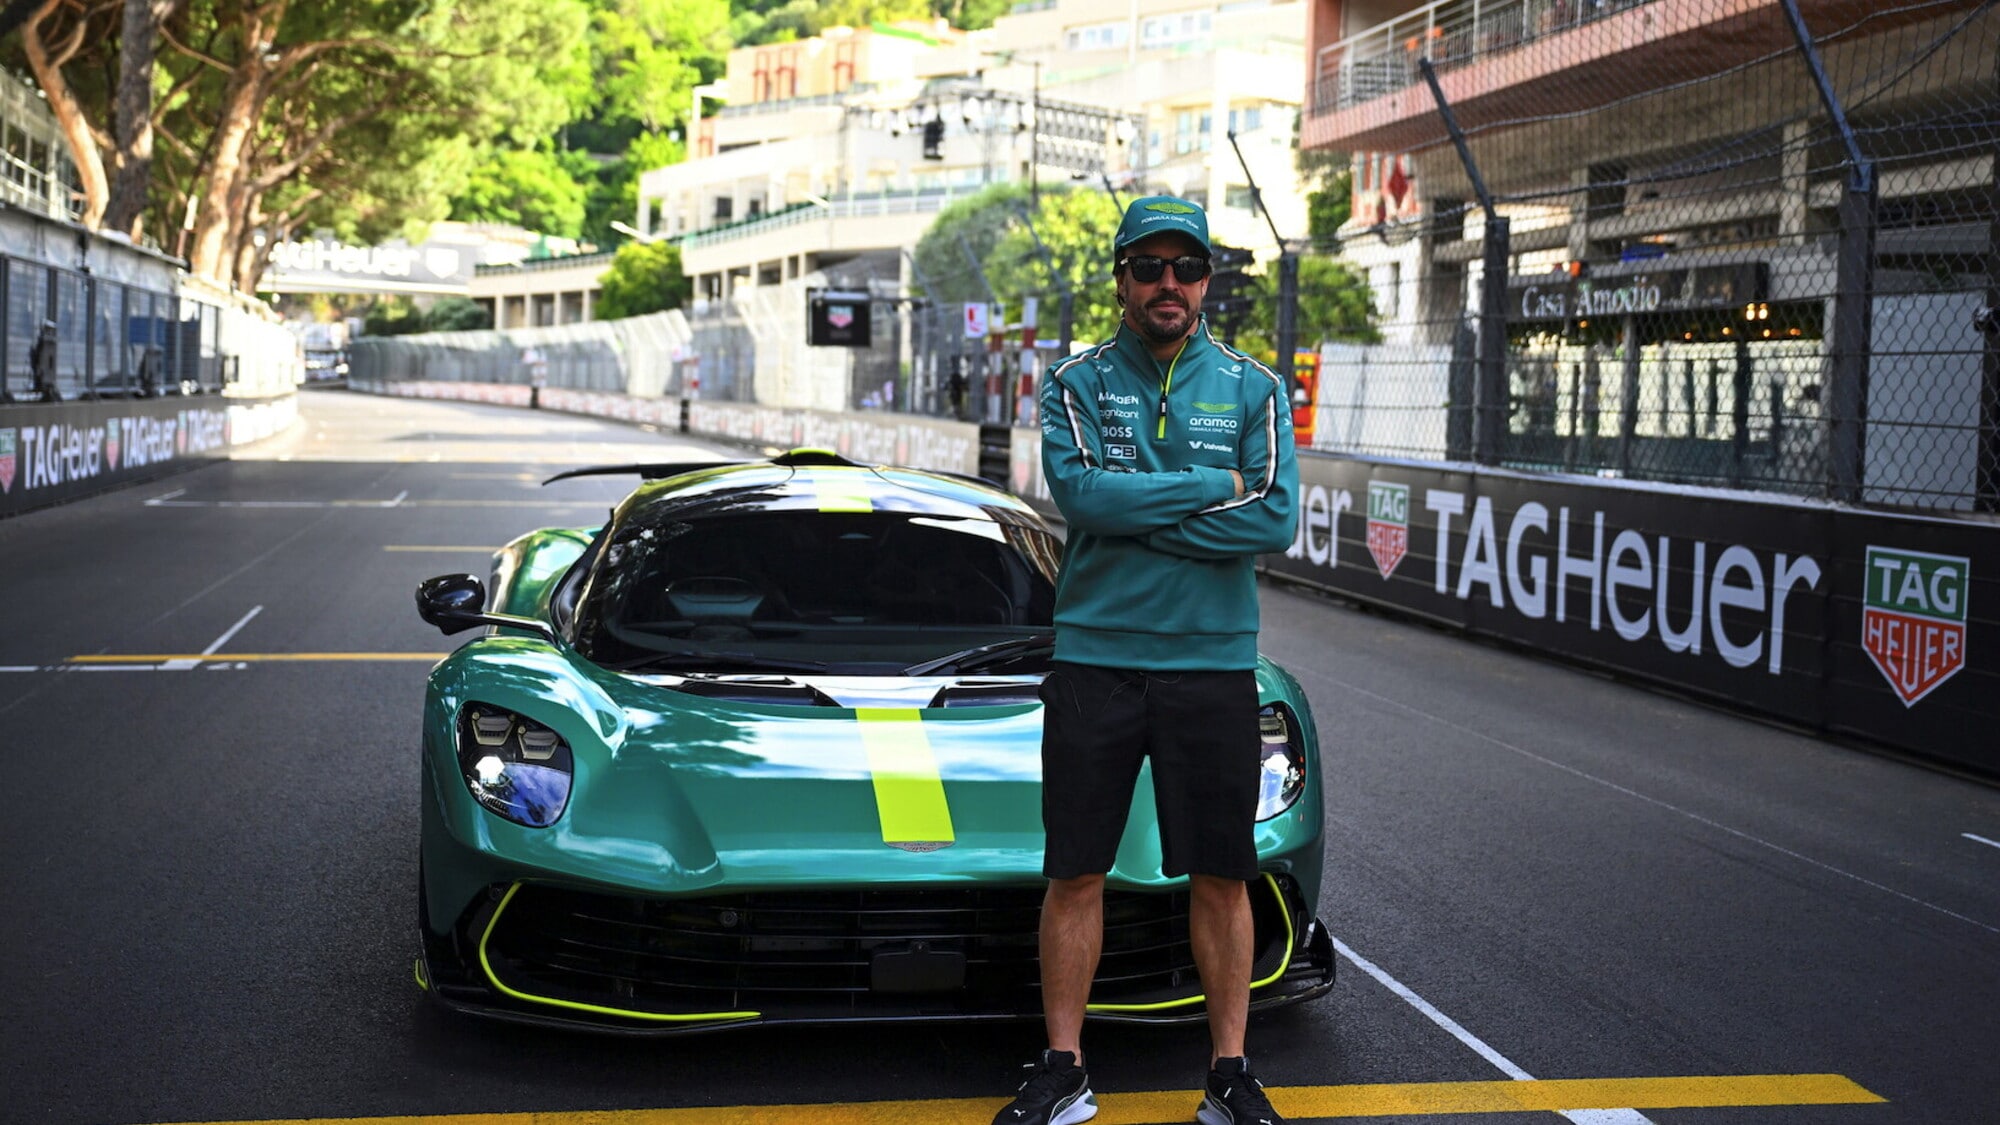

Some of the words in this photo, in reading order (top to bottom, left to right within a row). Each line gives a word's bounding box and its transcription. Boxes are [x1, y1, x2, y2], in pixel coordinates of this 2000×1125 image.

[1141, 215, 1170, 225] FORMULA
[1186, 219, 1199, 231] TEAM
[1522, 286, 1566, 318] Casa
[1099, 408, 1139, 420] ognizant
[1189, 417, 1237, 429] aramco
[1102, 426, 1133, 438] BOSS
[21, 424, 104, 490] TAGHeuer
[1371, 488, 1405, 521] TAG
[1426, 489, 1822, 675] TAGHeuer
[1874, 557, 1958, 614] TAG
[1868, 616, 1959, 694] HEUER
